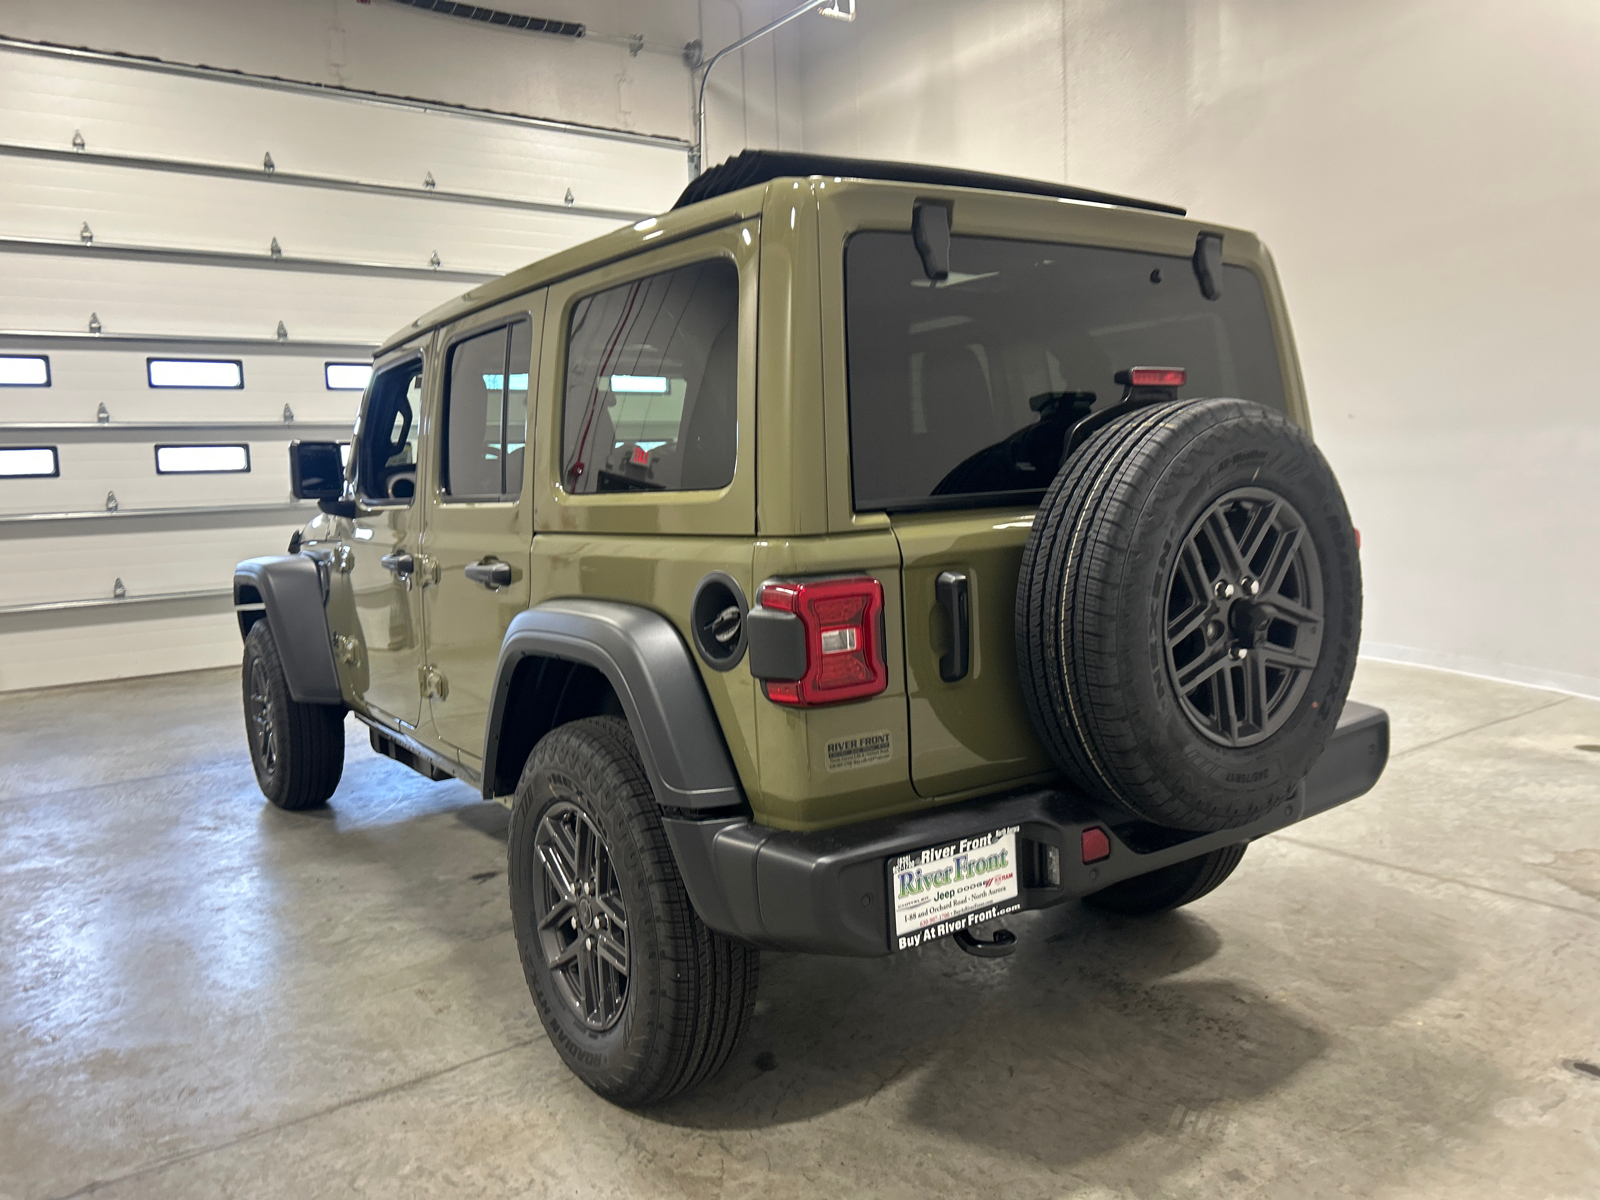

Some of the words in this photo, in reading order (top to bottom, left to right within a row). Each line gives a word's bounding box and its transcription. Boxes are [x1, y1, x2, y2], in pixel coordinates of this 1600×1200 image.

[828, 739, 857, 752] RIVER
[859, 734, 890, 747] FRONT
[921, 844, 956, 864] River
[959, 833, 992, 854] Front
[898, 865, 953, 899] River
[953, 848, 1009, 884] Front
[1001, 872, 1013, 881] RAM
[917, 908, 929, 919] and
[929, 901, 952, 916] Orchard
[953, 897, 967, 908] Road
[971, 891, 988, 903] North
[988, 886, 1006, 896] Aurora
[933, 888, 955, 902] Jeep
[898, 931, 921, 950] Buy
[923, 927, 936, 942] At
[937, 916, 966, 936] River
